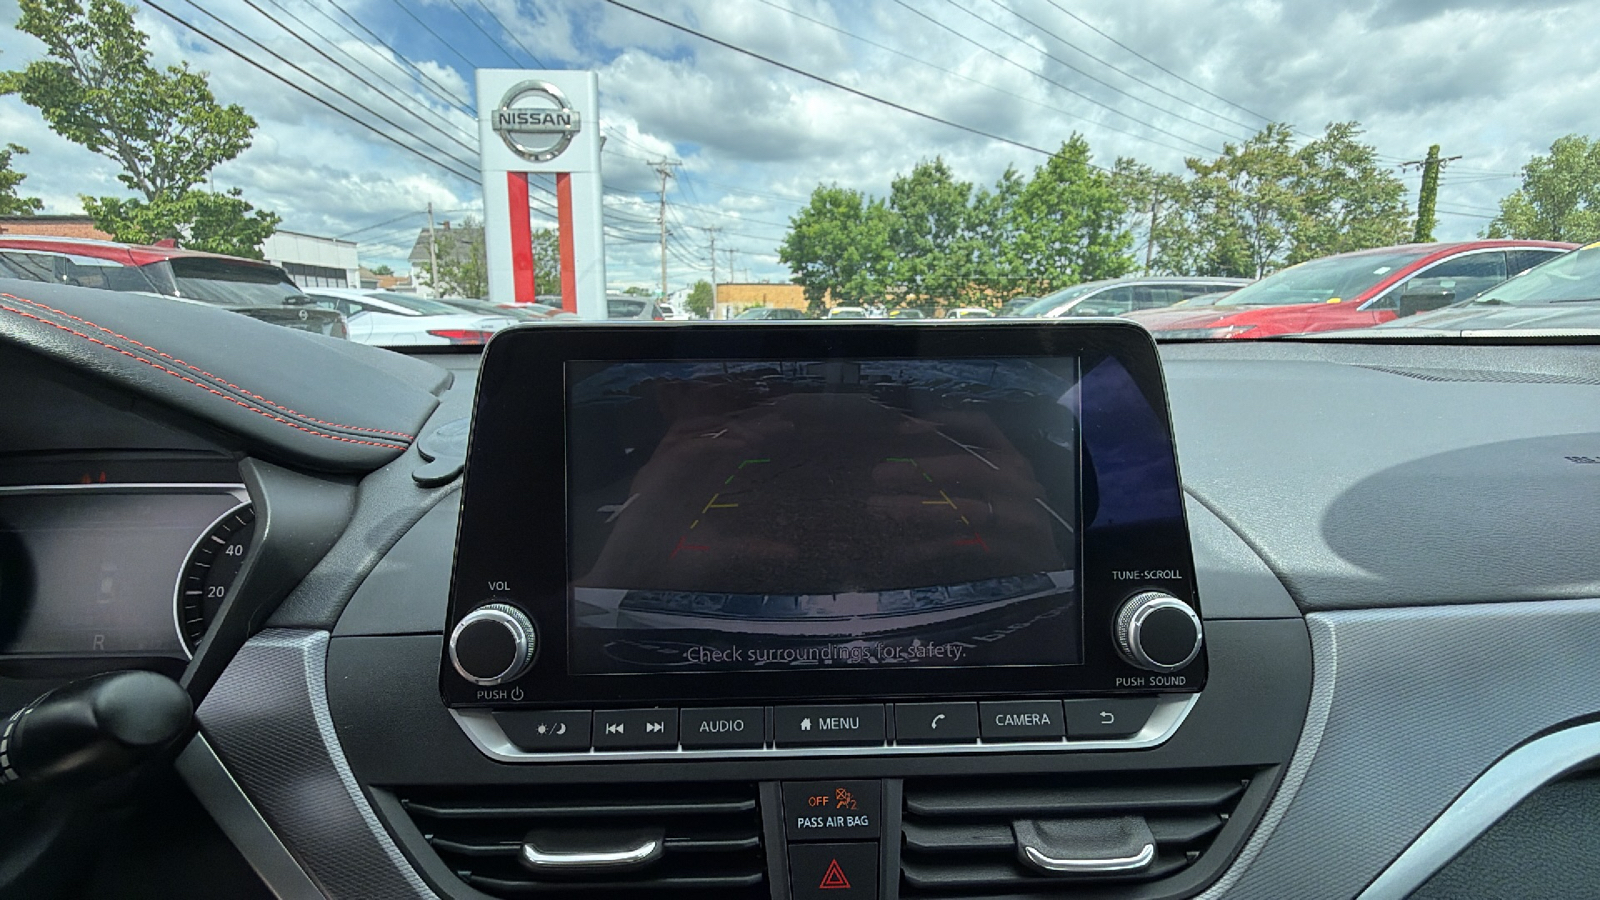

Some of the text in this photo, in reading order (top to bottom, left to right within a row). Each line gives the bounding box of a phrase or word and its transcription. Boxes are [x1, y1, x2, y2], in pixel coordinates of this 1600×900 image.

[499, 112, 571, 126] NISSAN
[225, 544, 243, 556] 40
[207, 586, 225, 598] 20
[488, 581, 511, 591] VOL
[93, 634, 105, 651] R
[686, 641, 967, 664] Check surroundings for safety.
[1116, 676, 1187, 687] PUSH SOUND
[477, 690, 507, 700] PUSH
[699, 719, 744, 733] AUDIO
[818, 717, 860, 730] MENU
[995, 713, 1051, 726] CAMERA
[808, 796, 829, 807] OFF
[797, 815, 869, 829] PASS AIR BAG
